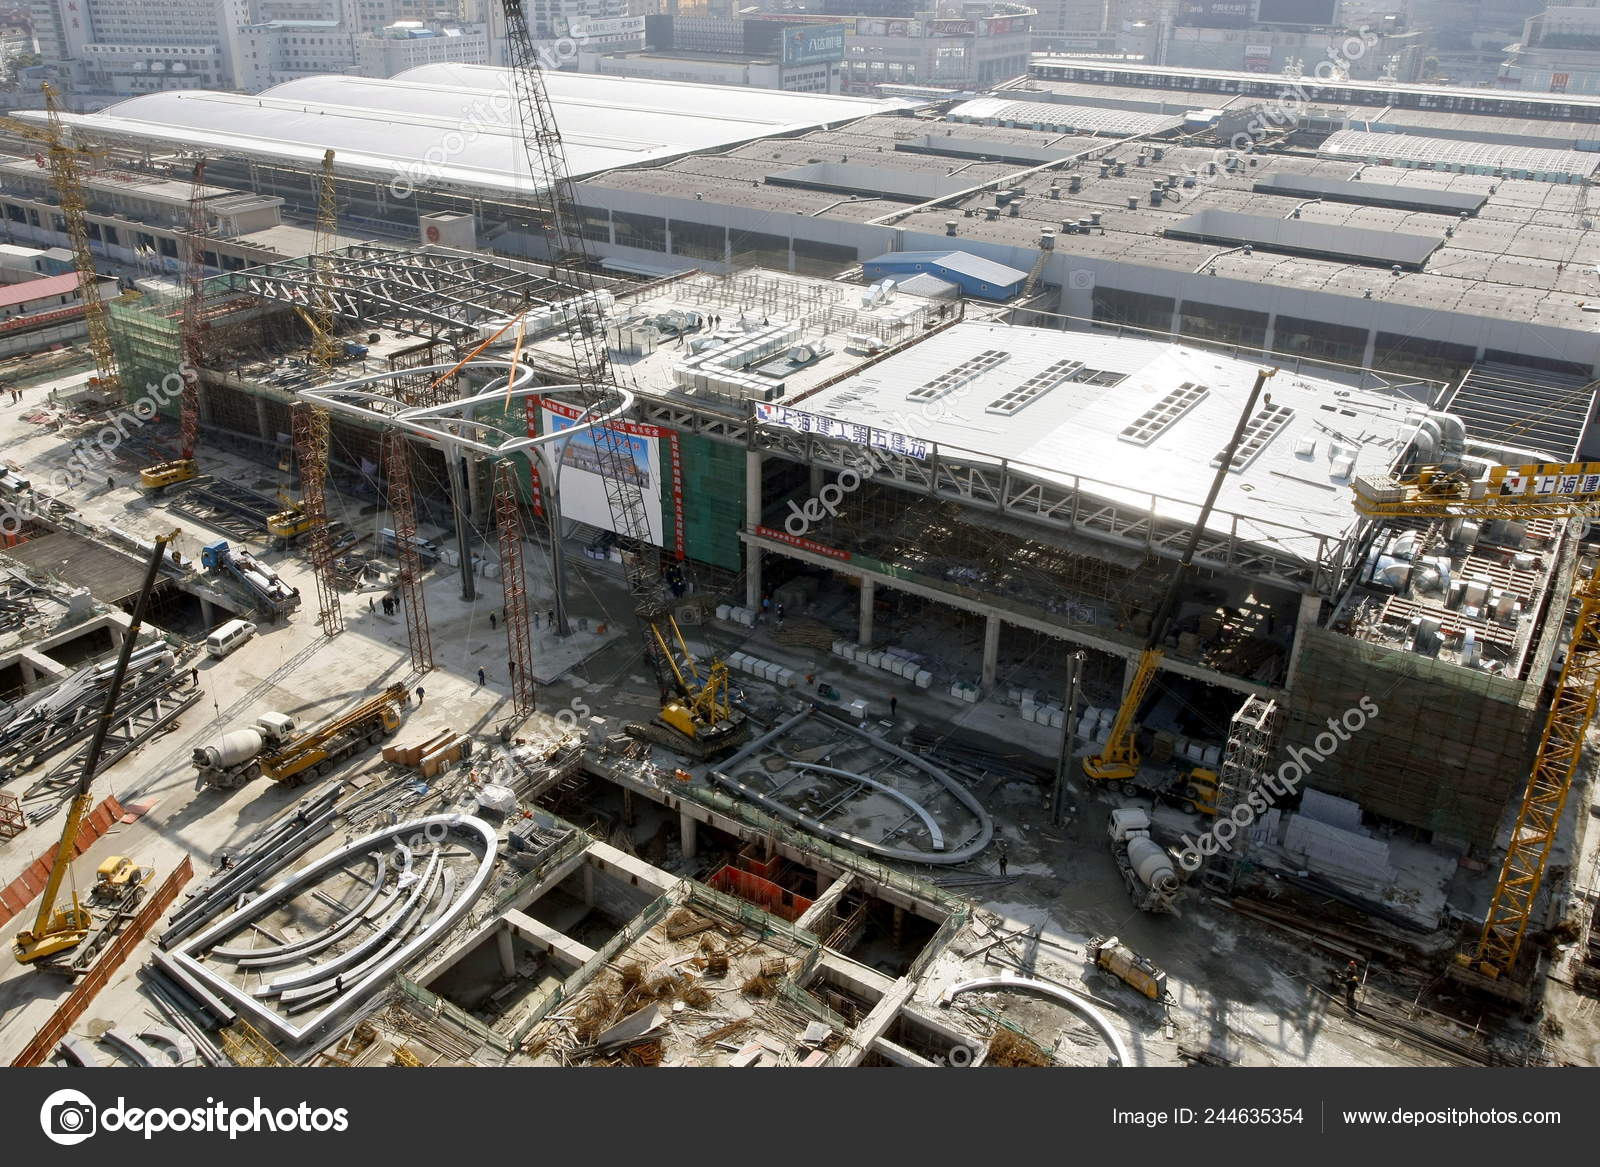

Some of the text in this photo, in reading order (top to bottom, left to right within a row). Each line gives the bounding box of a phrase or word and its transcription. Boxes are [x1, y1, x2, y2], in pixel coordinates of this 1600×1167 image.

[777, 406, 928, 460] 上海建工第五建筑
[1534, 474, 1600, 495] 上海建
